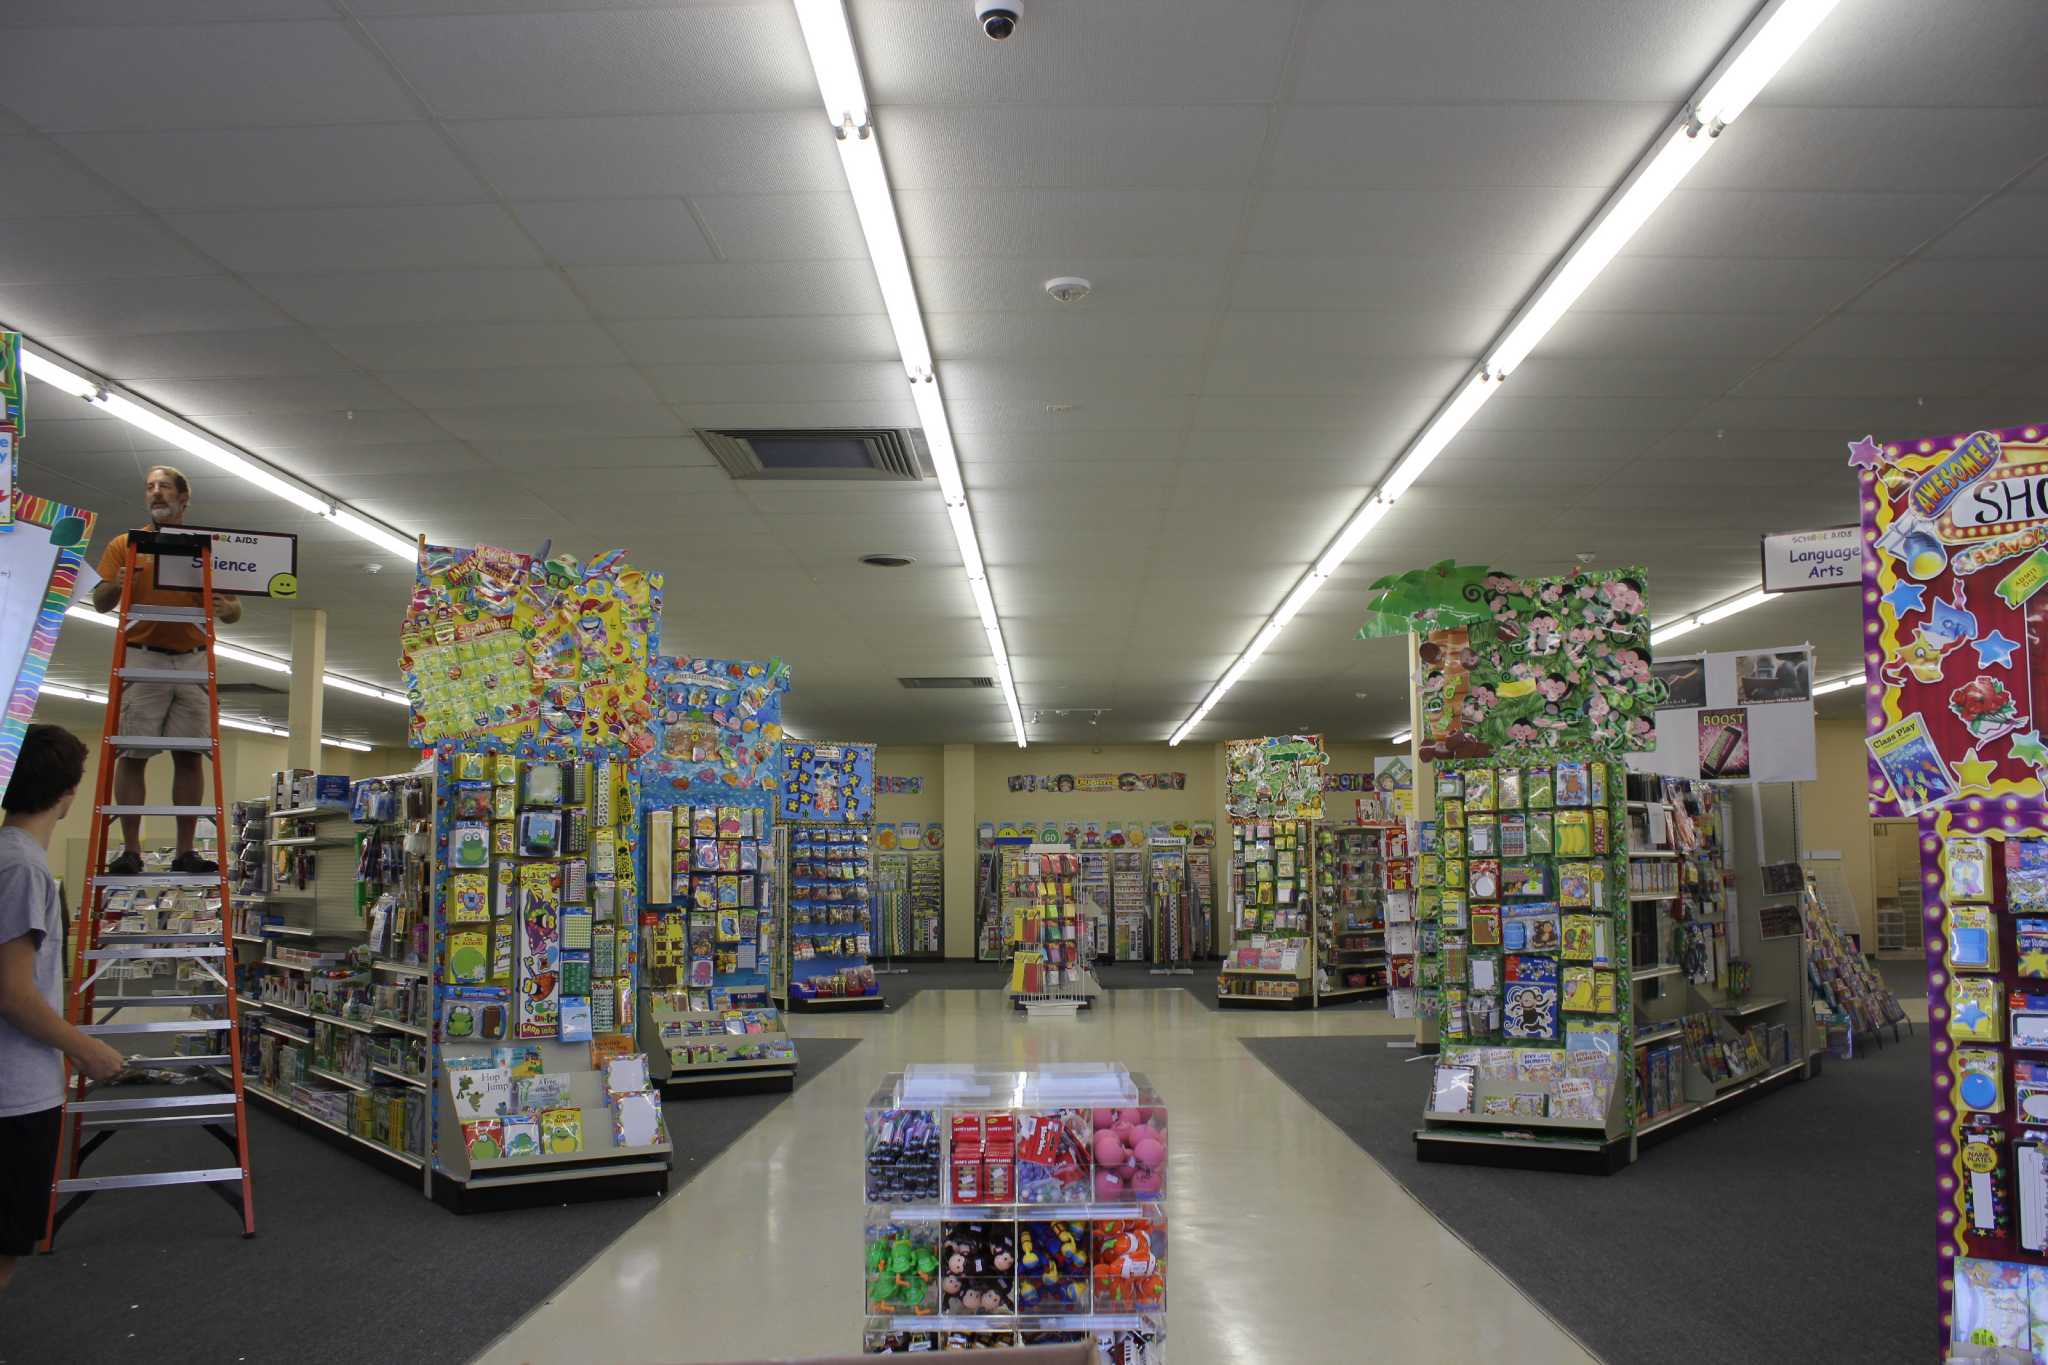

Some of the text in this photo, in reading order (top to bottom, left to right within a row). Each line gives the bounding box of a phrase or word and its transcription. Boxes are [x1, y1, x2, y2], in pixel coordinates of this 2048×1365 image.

[1915, 436, 1991, 513] AWESOME!
[235, 536, 258, 545] AIDS
[1831, 530, 1852, 539] AIDS
[1789, 546, 1861, 564] Language
[191, 554, 257, 573] Sience
[1808, 565, 1844, 578] Arts
[461, 617, 510, 639] September
[1703, 714, 1744, 726] BOOST
[1872, 722, 1916, 749] Class Play
[481, 1072, 501, 1083] Hop
[487, 1082, 509, 1092] Jump
